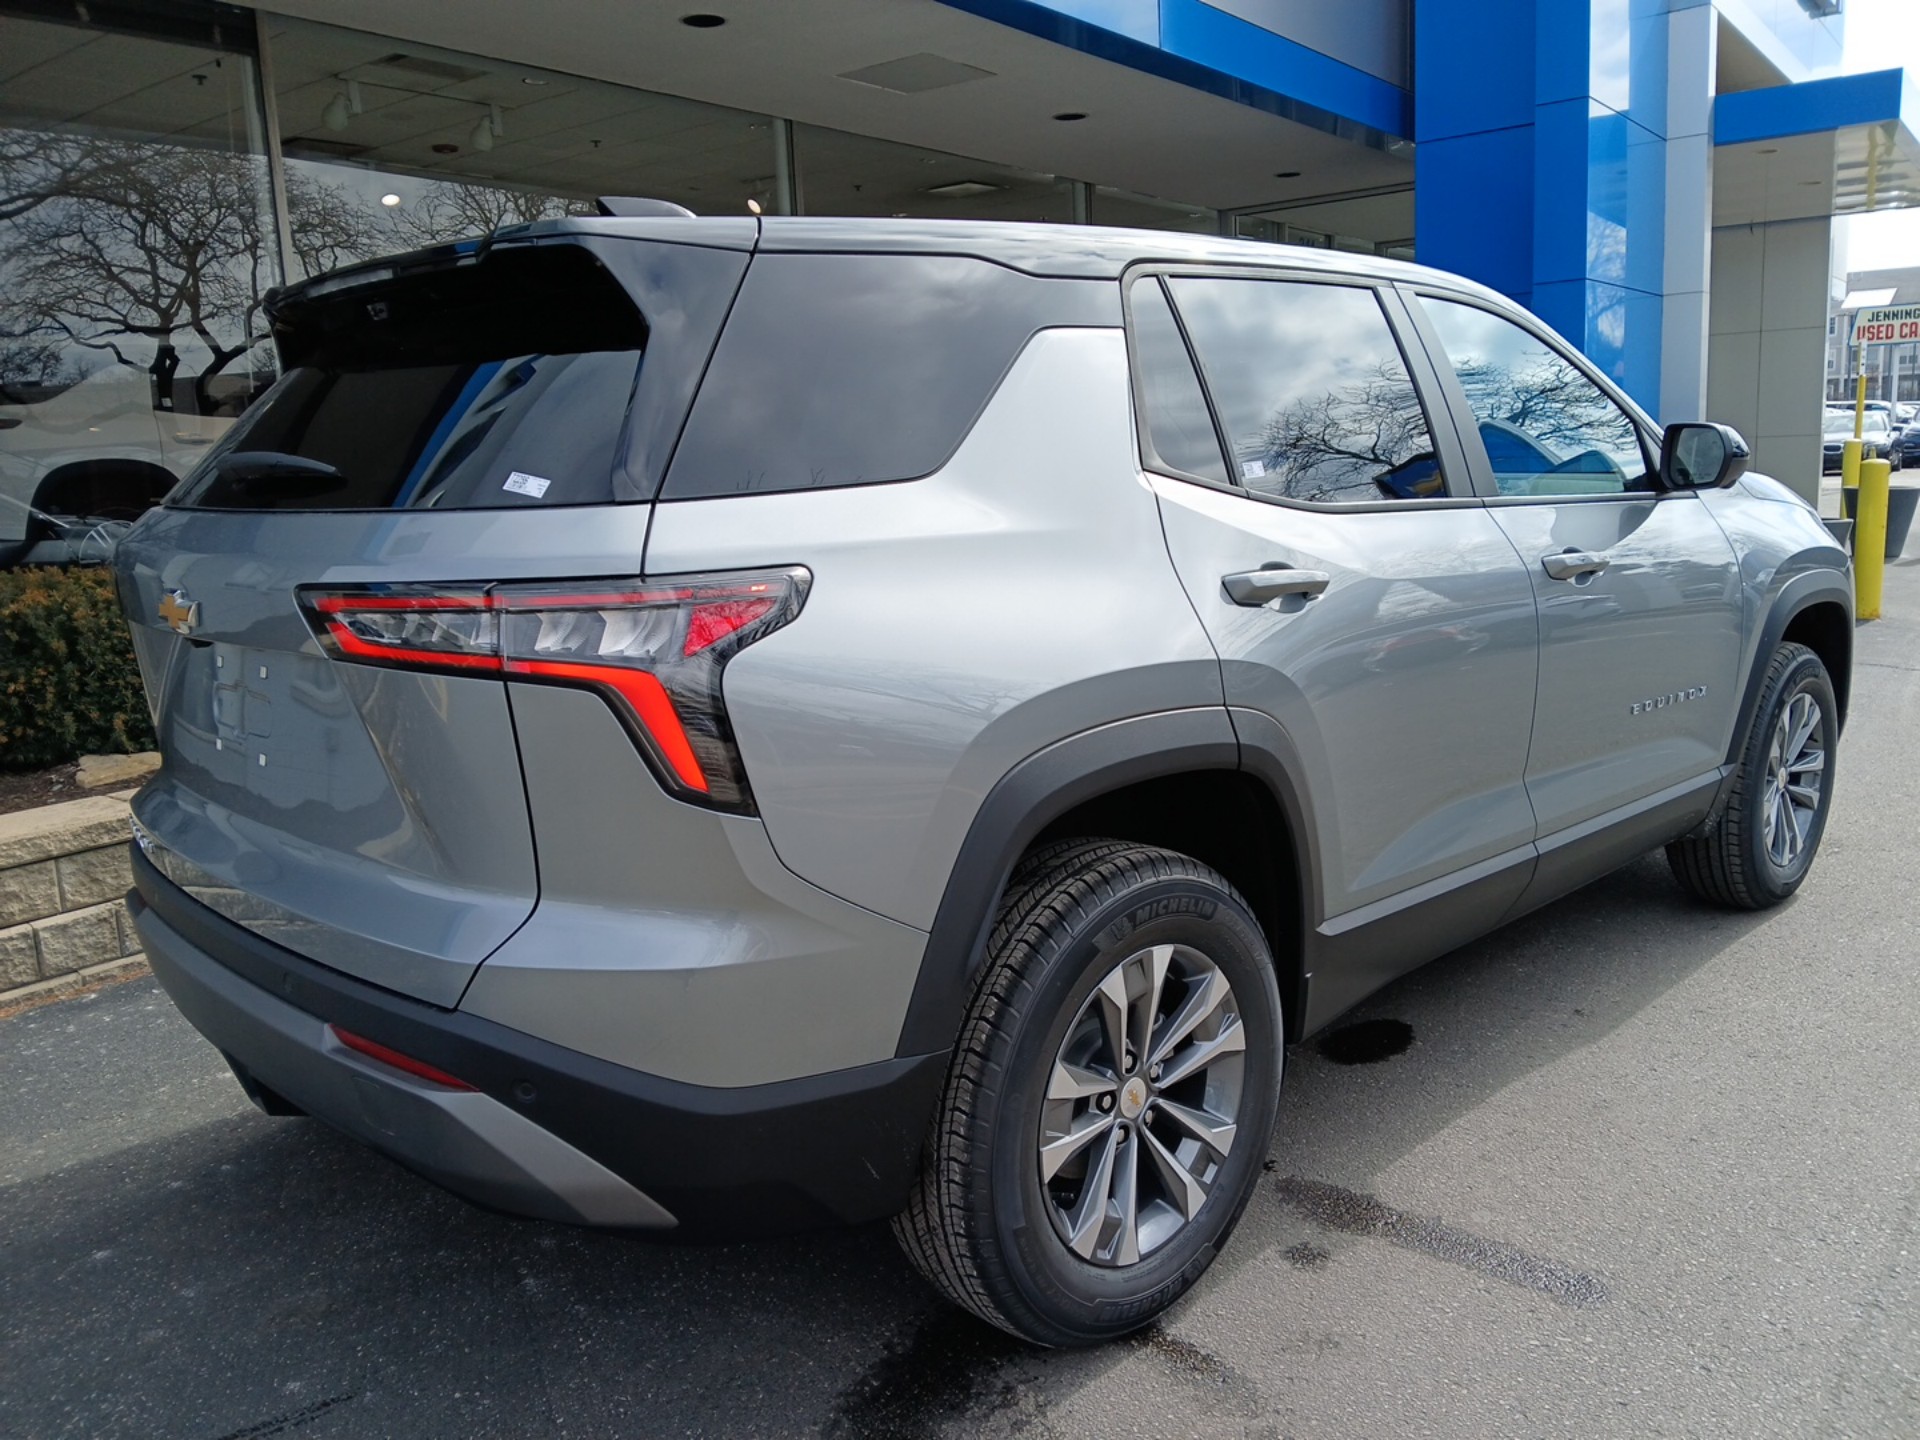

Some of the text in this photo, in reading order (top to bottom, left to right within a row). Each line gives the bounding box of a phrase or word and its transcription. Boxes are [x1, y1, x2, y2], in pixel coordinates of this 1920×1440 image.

[1857, 324, 1894, 341] USED
[1630, 685, 1707, 715] EQUINOX
[1135, 898, 1216, 925] MICHELIN
